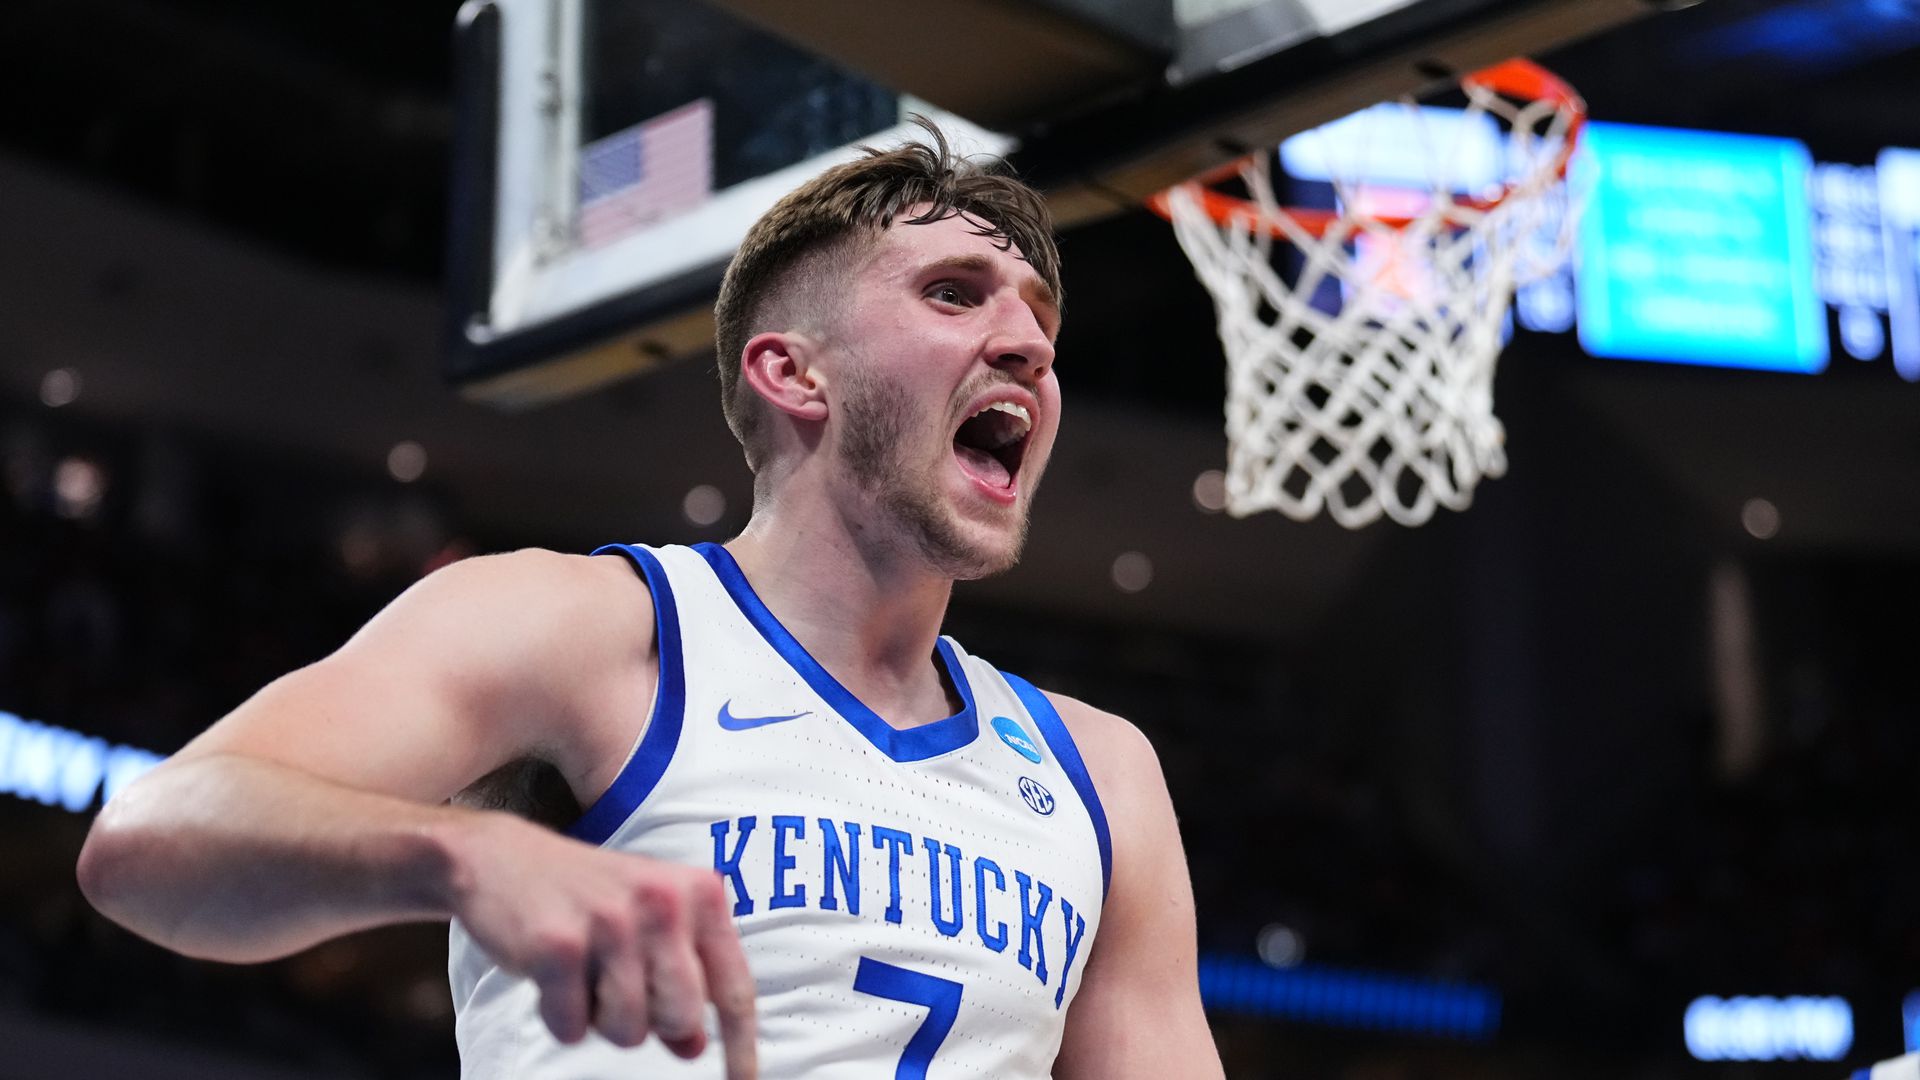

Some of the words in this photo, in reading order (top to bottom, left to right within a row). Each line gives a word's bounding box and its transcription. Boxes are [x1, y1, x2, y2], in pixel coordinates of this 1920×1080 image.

[1019, 776, 1054, 814] SEC
[711, 815, 1085, 1010] KENTUCKY
[853, 956, 963, 1080] 7
